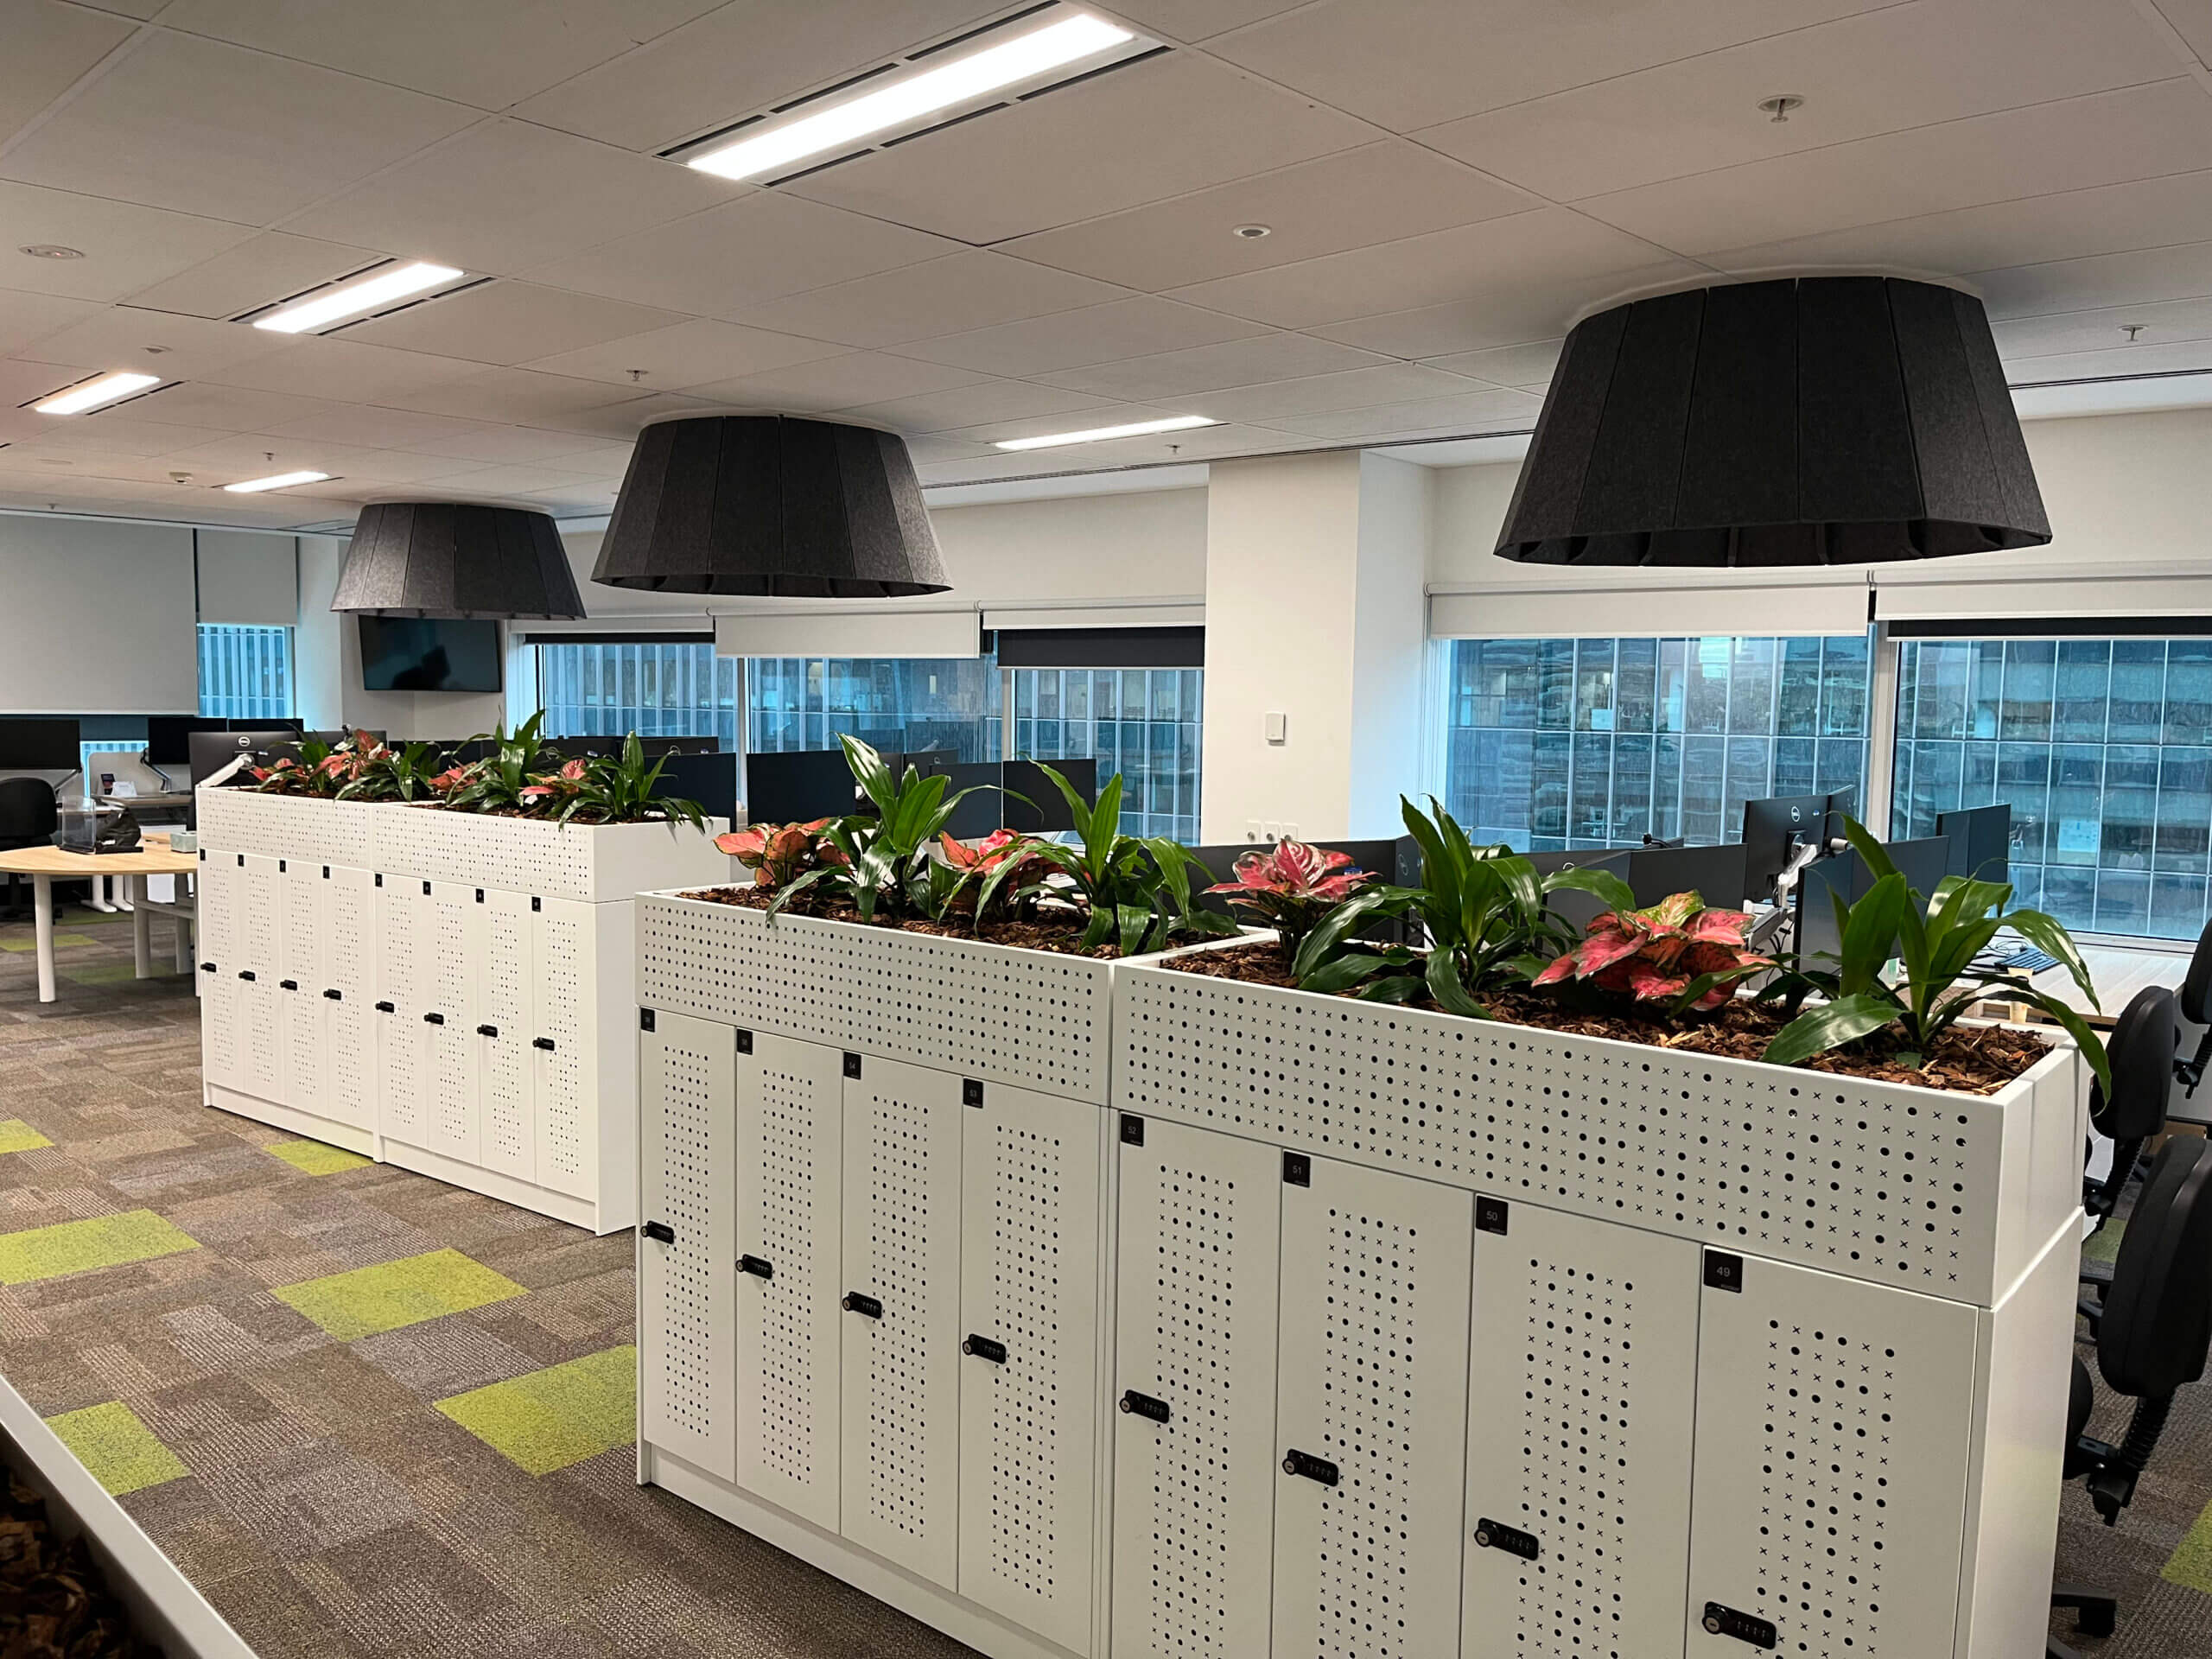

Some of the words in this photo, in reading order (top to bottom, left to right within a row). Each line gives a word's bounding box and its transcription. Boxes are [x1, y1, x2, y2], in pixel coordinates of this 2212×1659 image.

[1128, 1126, 1136, 1135] 52
[1293, 1165, 1301, 1175] 51
[1486, 1211, 1497, 1221] 50
[1717, 1266, 1730, 1277] 49
